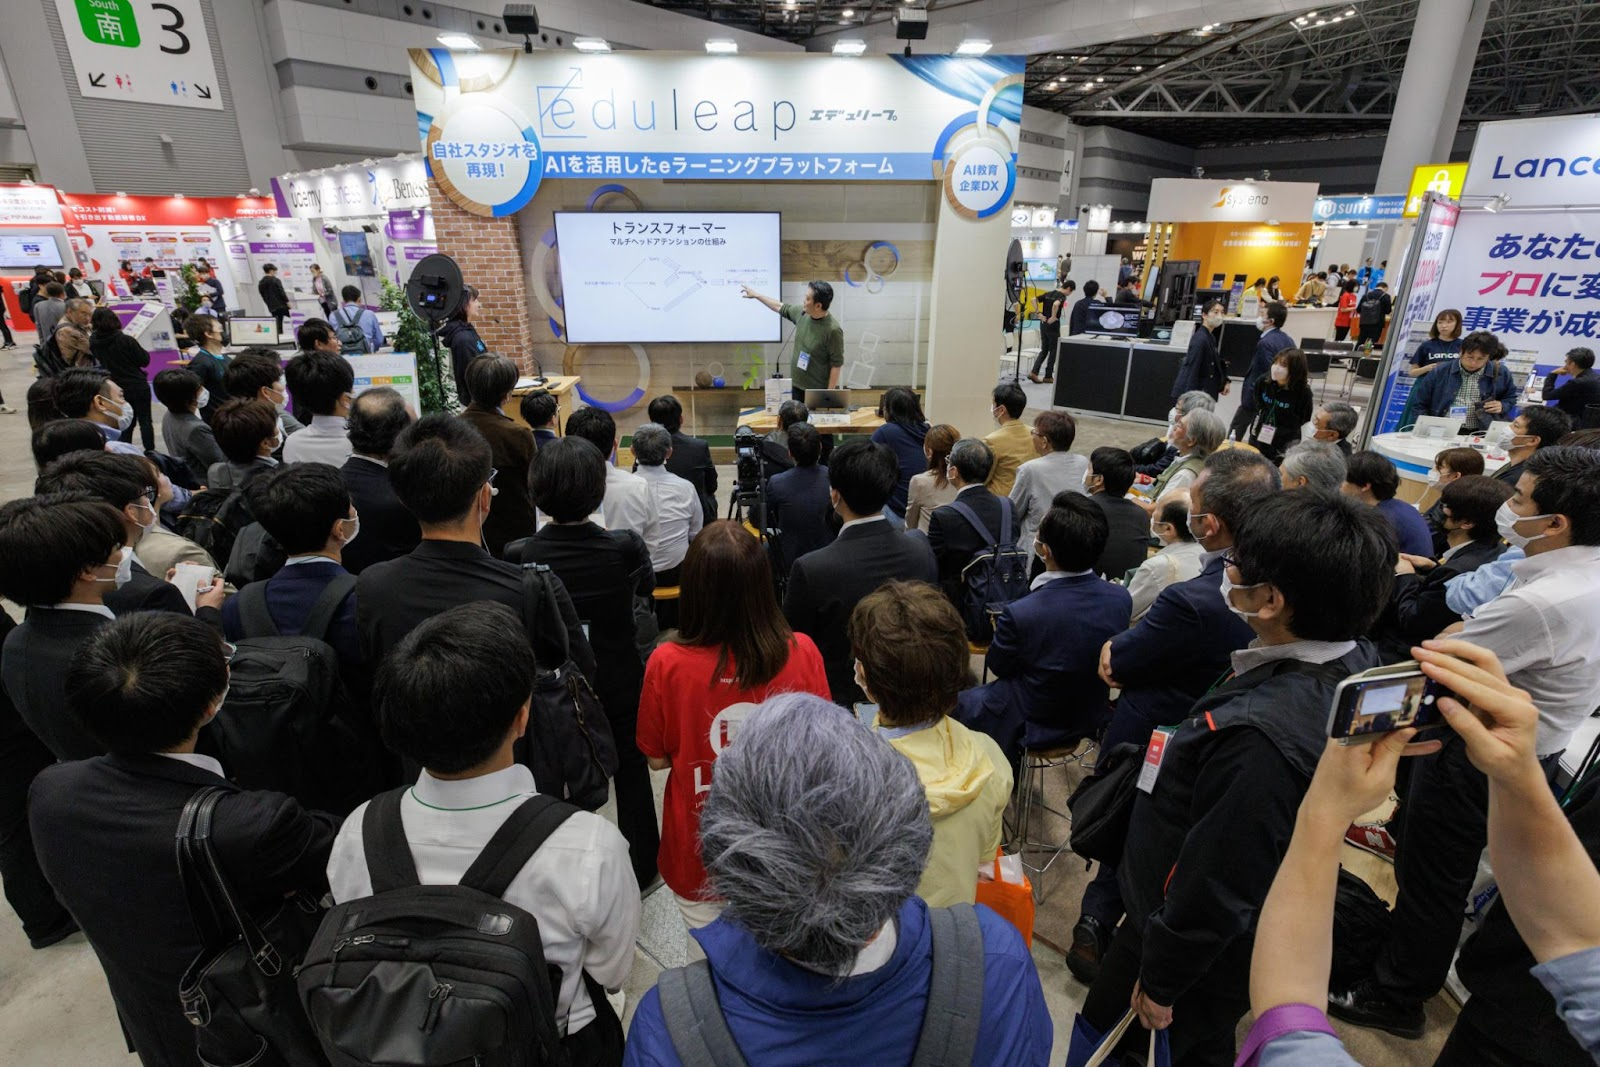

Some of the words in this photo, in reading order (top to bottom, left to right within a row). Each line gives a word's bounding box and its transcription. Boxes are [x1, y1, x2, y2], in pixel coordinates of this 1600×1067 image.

[95, 13, 125, 42] 南
[151, 3, 190, 55] 3
[551, 87, 796, 141] eduleap
[433, 142, 537, 160] 自社スタジオを
[466, 162, 505, 178] 再現！
[544, 154, 895, 175] AIを活用したeラーニングプラットフォーム
[963, 164, 998, 176] AI教育
[1064, 160, 1070, 177] 4
[959, 180, 999, 192] 企業DX
[1337, 203, 1371, 214] SUITE
[612, 221, 727, 234] トランスフォーマー
[609, 237, 727, 246] マルチヘッドアテンションの仕組み
[1489, 233, 1600, 260] あなた
